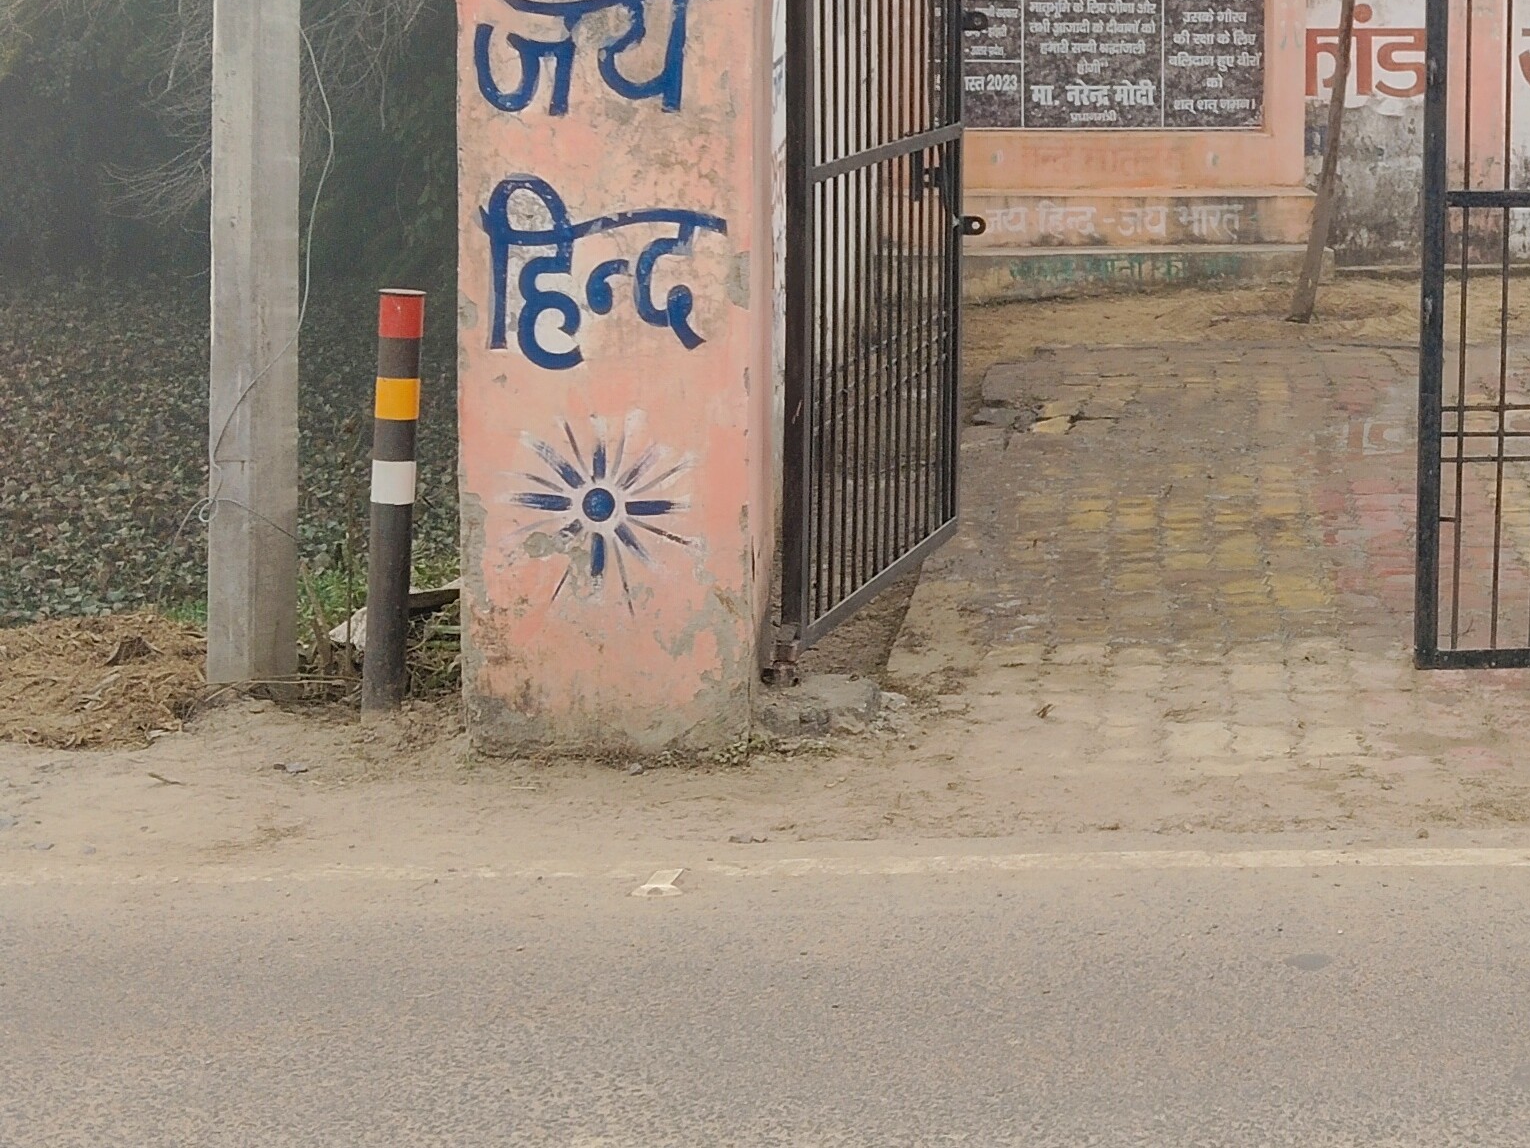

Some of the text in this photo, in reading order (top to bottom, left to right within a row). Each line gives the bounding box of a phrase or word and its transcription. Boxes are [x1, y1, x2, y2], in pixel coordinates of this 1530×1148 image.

[1072, 0, 1085, 14] के
[1092, 19, 1104, 34] के
[1141, 19, 1156, 34] को
[1172, 29, 1190, 45] की
[1216, 30, 1231, 45] के
[1233, 28, 1257, 46] लिए
[1216, 55, 1235, 72] हुए
[986, 74, 1018, 91] 2023
[1206, 73, 1223, 89] को
[1030, 78, 1157, 107] मा. नरेन्द्र मोदी
[1118, 206, 1169, 237] जय
[1176, 205, 1244, 241] भारत
[477, 174, 728, 371] हिन्द
